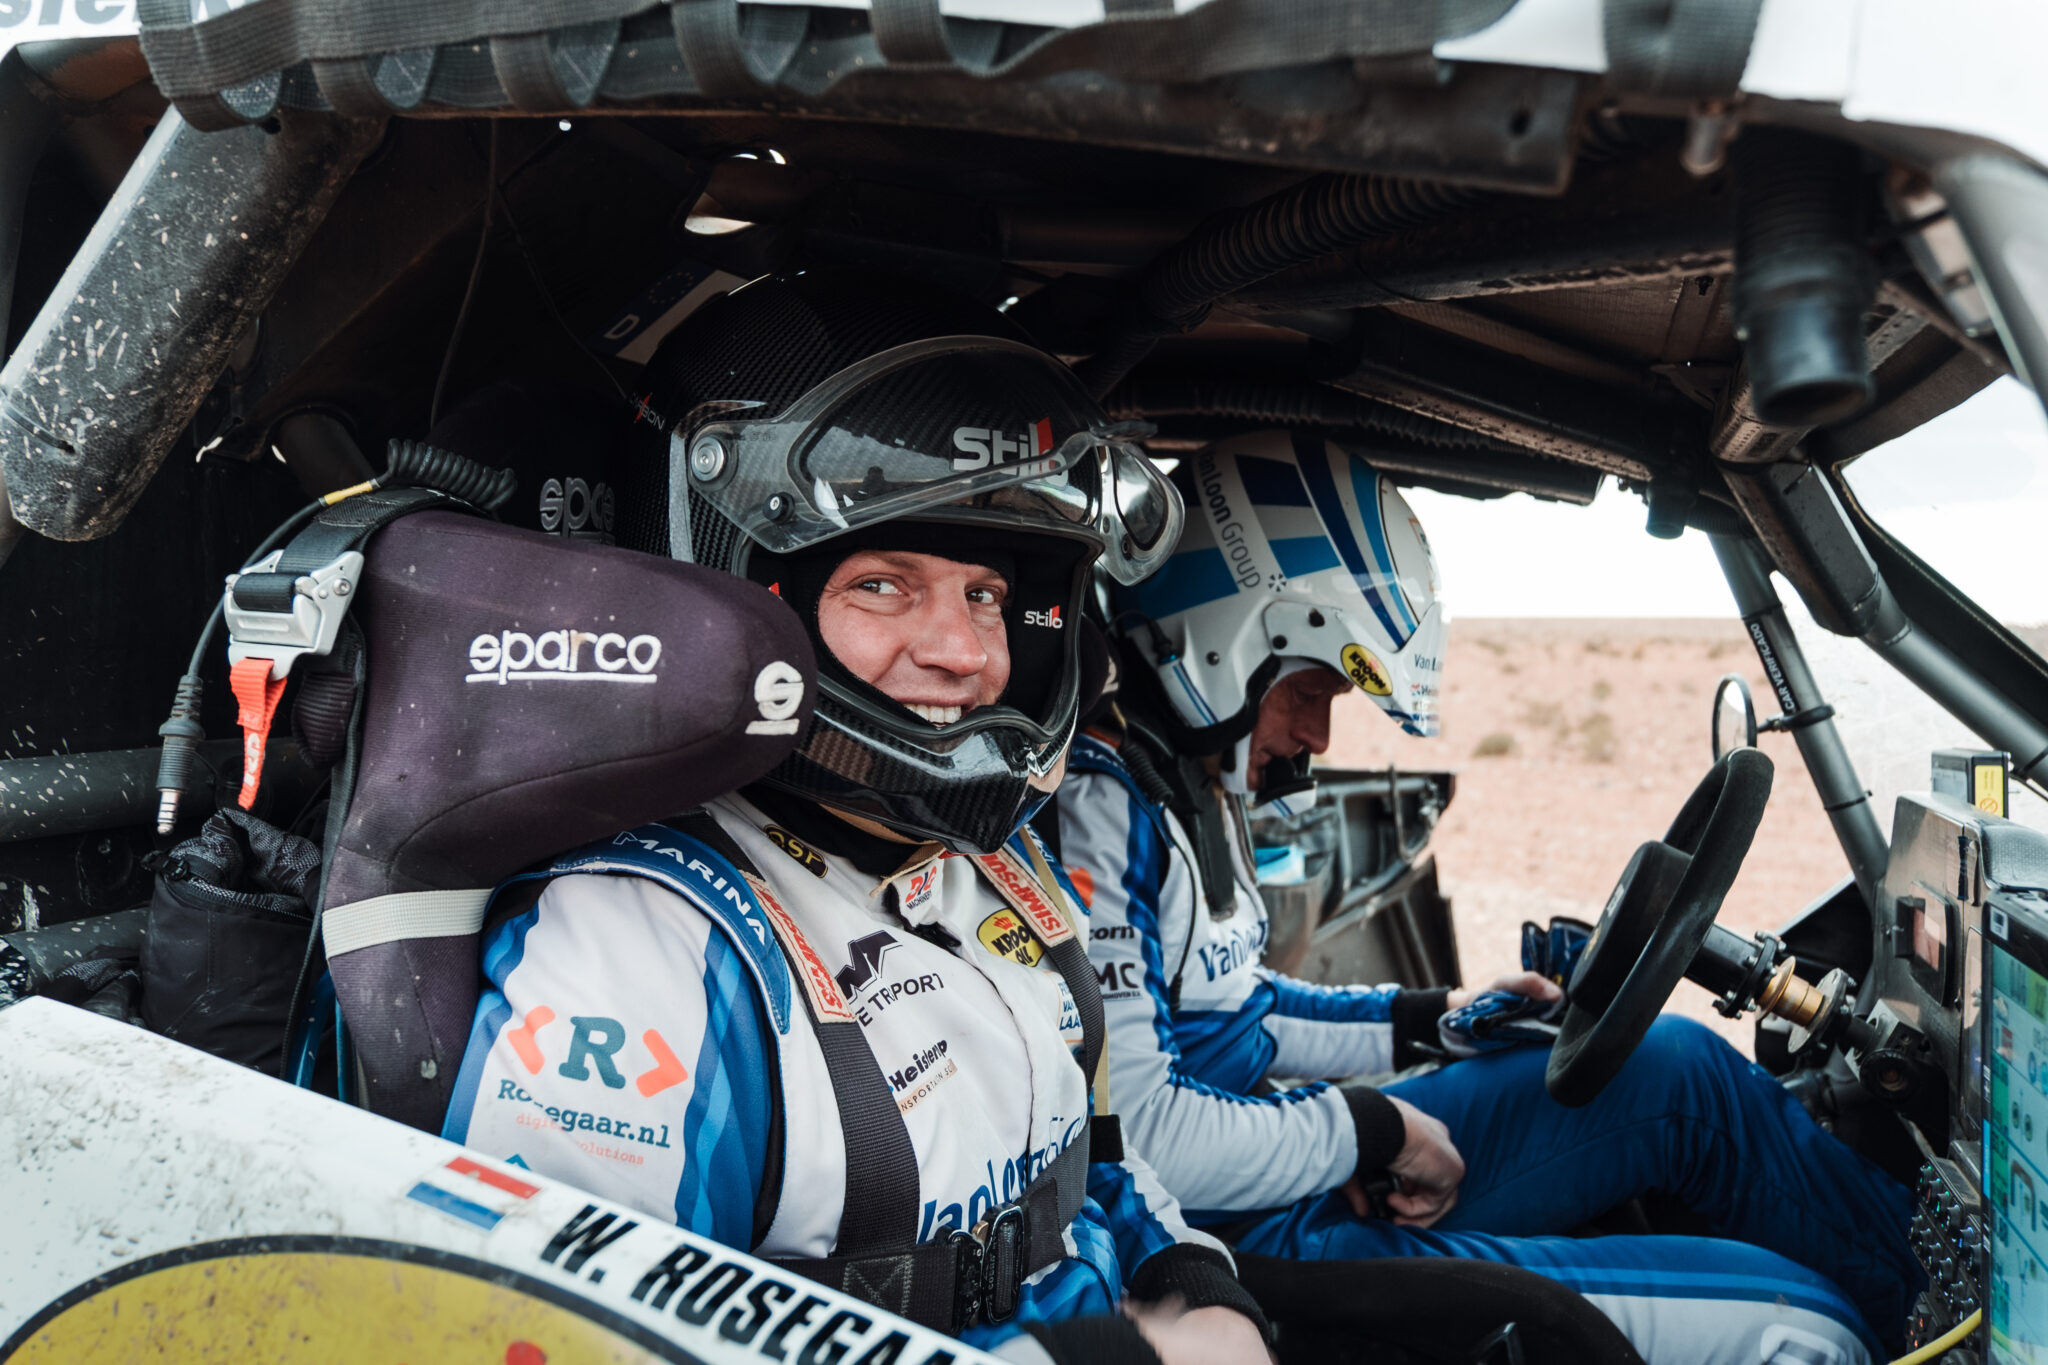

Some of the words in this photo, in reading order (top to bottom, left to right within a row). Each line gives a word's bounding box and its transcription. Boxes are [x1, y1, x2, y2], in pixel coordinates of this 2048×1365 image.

[952, 417, 1069, 487] Stilo
[1220, 521, 1261, 588] Group
[1024, 605, 1063, 629] Stilo
[466, 629, 662, 685] sparco
[1349, 651, 1386, 689] KROON
[1750, 622, 1784, 688] VERIFICADO
[1779, 686, 1795, 710] CAR
[906, 889, 934, 911] MACHINERY
[991, 925, 1032, 957] KROO
[1059, 1014, 1082, 1031] LAA
[497, 1079, 671, 1148] Roegaar.nl
[574, 1141, 645, 1166] olutions
[540, 1203, 638, 1284] W.
[630, 1242, 957, 1365] ROSEGA
